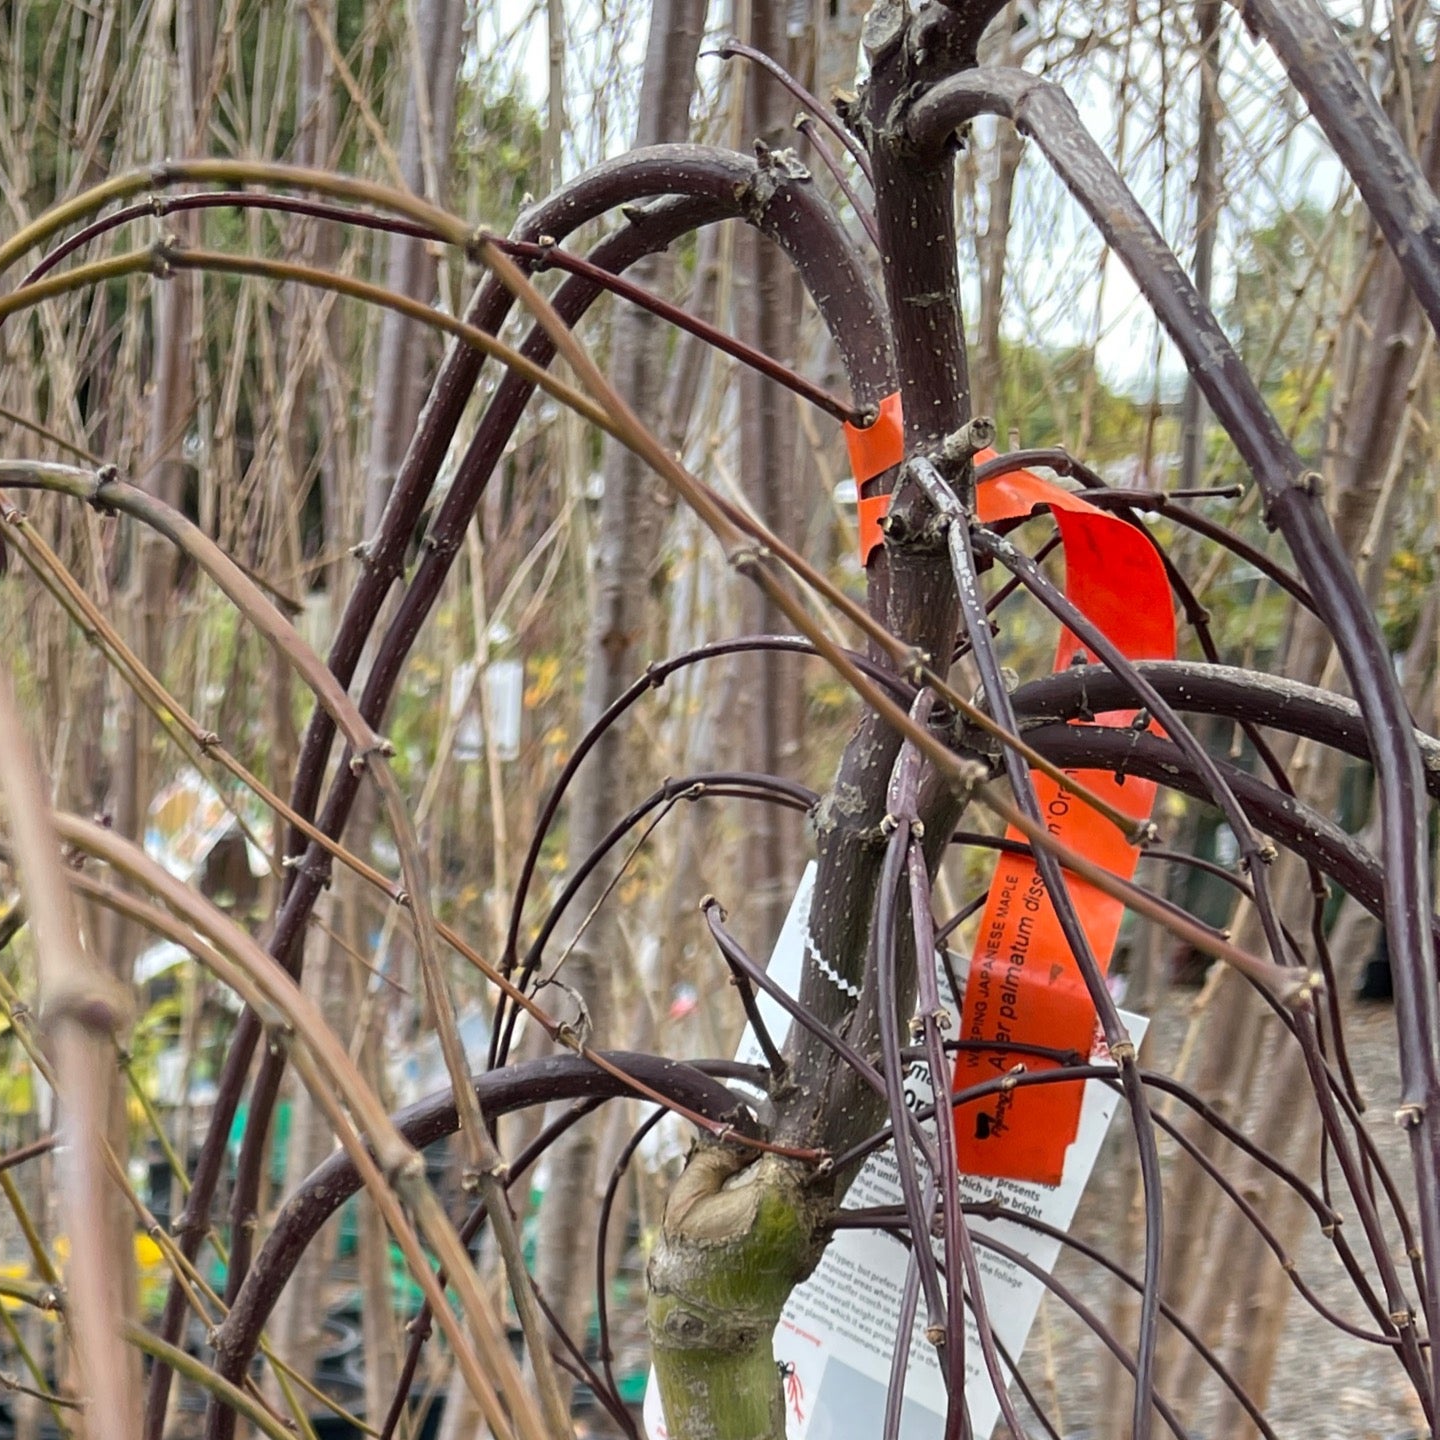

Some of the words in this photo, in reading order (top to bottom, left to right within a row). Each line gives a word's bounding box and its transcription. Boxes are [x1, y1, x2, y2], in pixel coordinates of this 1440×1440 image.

[981, 922, 1005, 996] JAPANESE
[997, 875, 1018, 918] MAPLE
[988, 1022, 1010, 1071] Aer
[1000, 917, 1034, 1020] palmatum
[878, 1169, 898, 1183] until
[997, 1178, 1040, 1201] presents
[1011, 1198, 1043, 1217] bright
